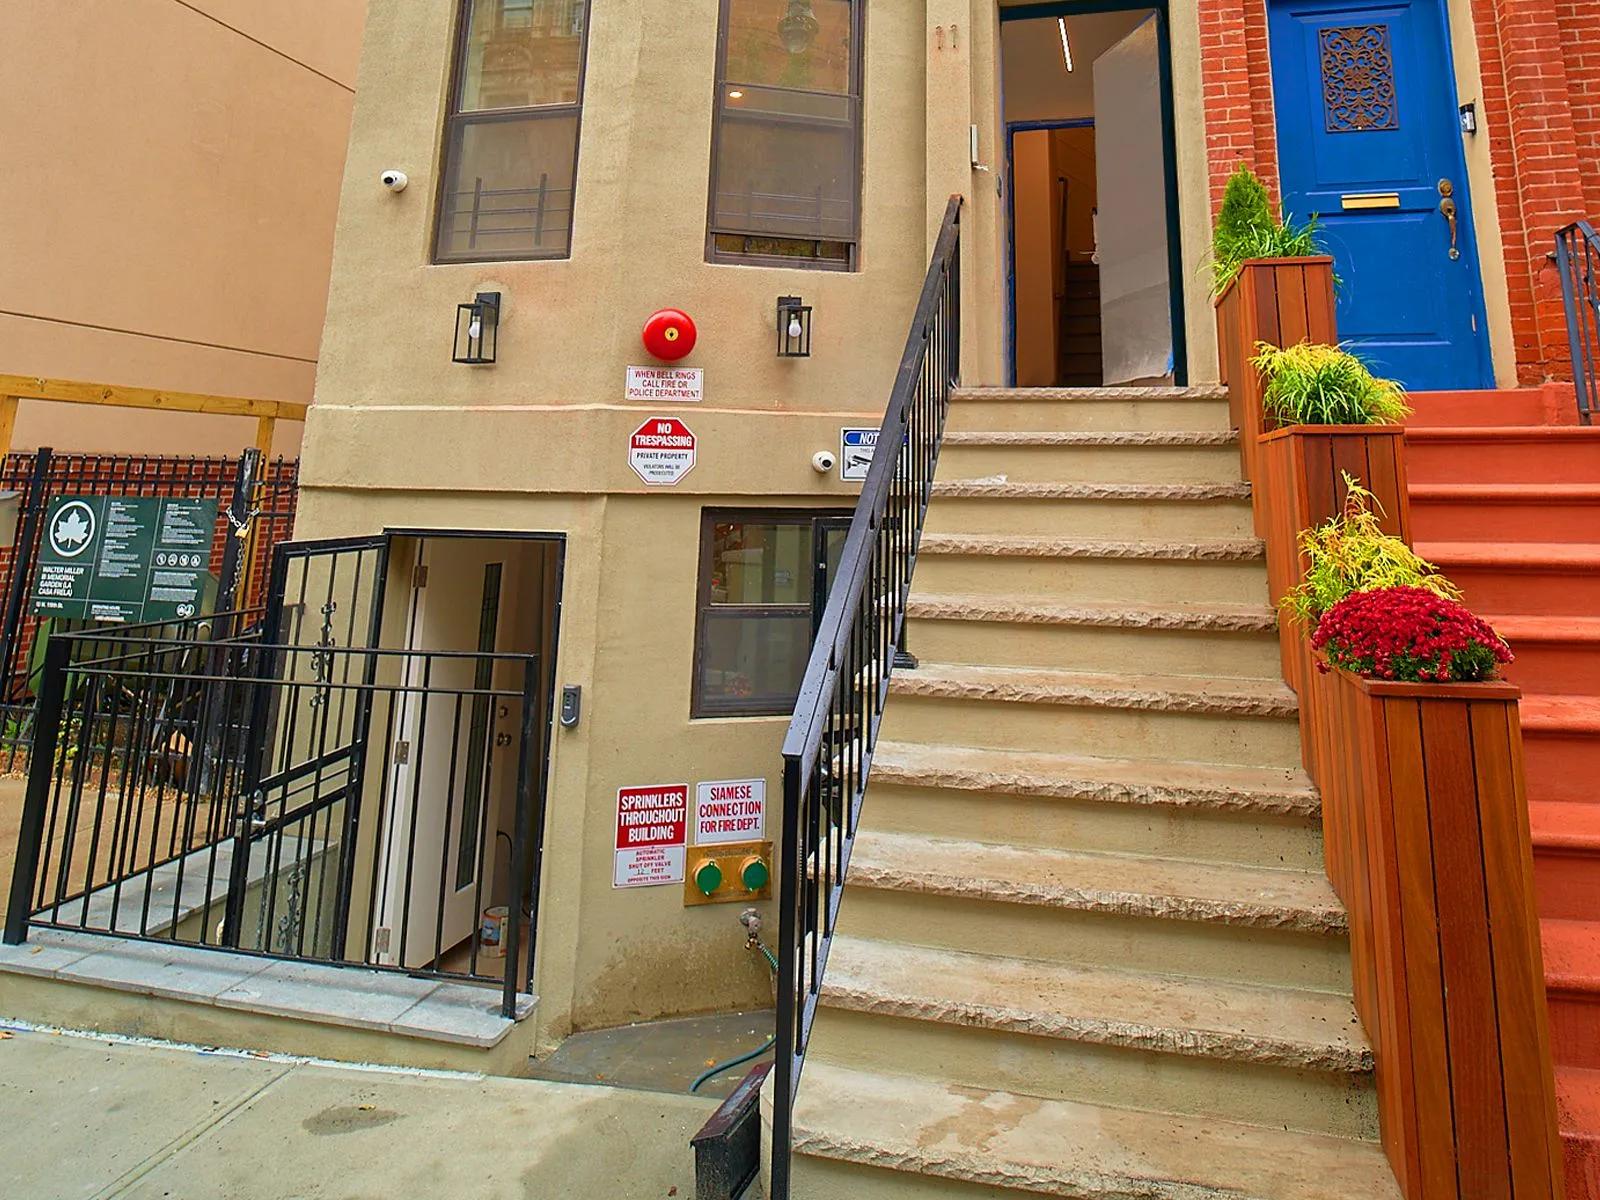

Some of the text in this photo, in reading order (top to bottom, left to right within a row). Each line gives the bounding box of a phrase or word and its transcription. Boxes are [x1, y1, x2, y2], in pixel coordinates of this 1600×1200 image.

[635, 370, 696, 380] WHEN BELL RINGS
[642, 379, 688, 389] CALL FIRE OR
[629, 388, 699, 398] POLICE DEPARTMENT
[657, 422, 672, 434] NO
[635, 435, 692, 447] TRESPASSING
[859, 432, 880, 444] NOT
[636, 452, 659, 460] PRIVATE
[710, 785, 752, 801] SIAMESE
[621, 792, 683, 811] SPRINKLERS
[699, 800, 761, 818] CONNECTION
[619, 807, 685, 827] THROUGHOUT
[700, 817, 760, 834] FOR FIRE DEPT.
[628, 825, 675, 843] BUILDING
